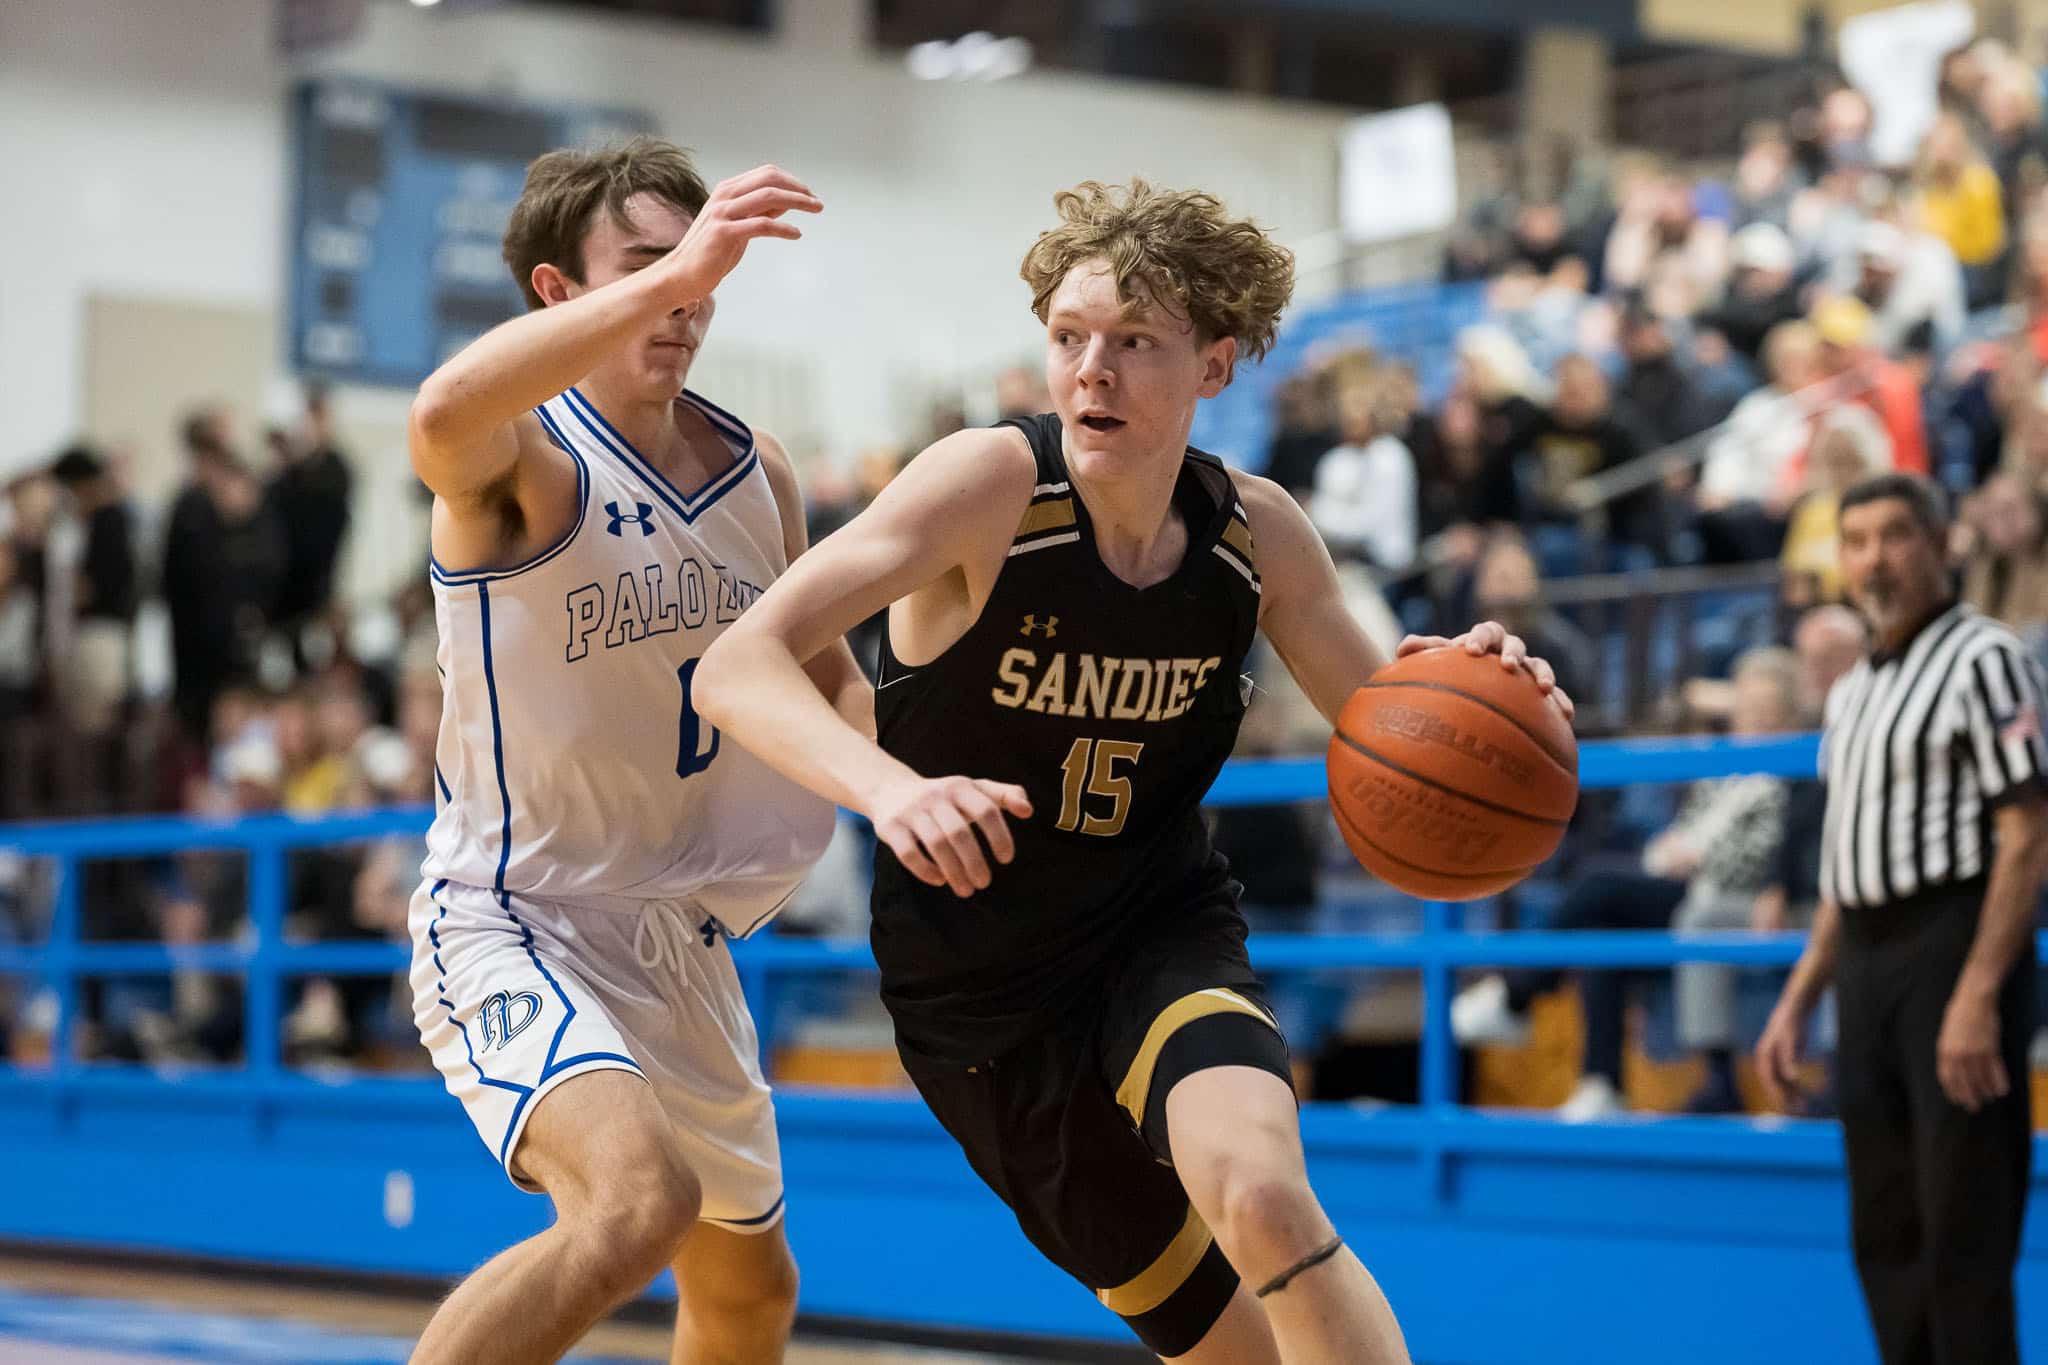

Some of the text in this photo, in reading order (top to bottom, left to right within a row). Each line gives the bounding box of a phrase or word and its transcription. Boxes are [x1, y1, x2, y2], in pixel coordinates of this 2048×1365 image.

[566, 558, 708, 663] PALO
[991, 647, 1222, 722] SANDIES
[1054, 737, 1145, 837] 15
